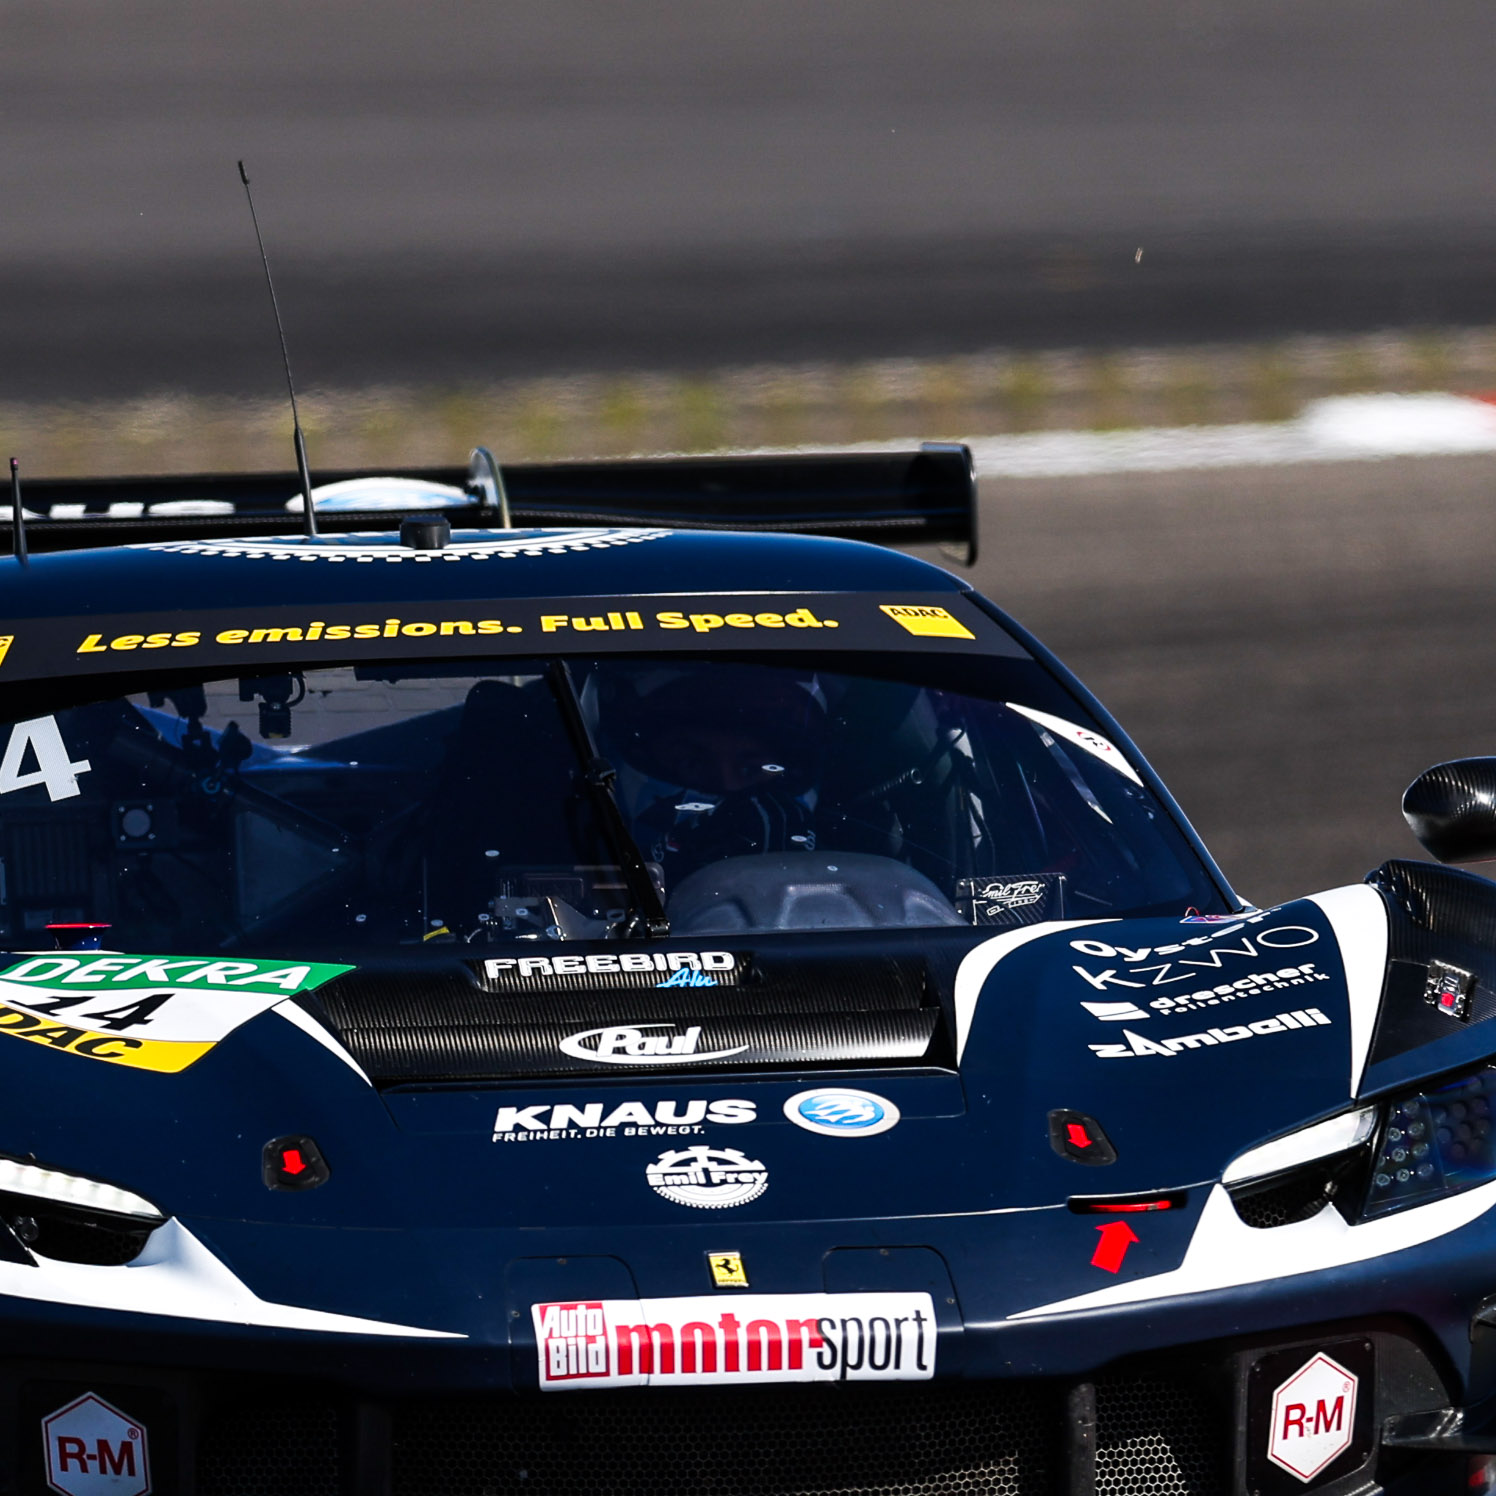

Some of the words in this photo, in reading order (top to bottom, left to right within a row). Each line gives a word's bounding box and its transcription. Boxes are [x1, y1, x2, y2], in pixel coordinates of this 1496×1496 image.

[889, 606, 950, 620] ADAC
[76, 631, 201, 653] Less
[216, 618, 523, 645] emissions.
[540, 611, 645, 632] Full
[655, 608, 840, 634] Speed.
[484, 951, 736, 979] FREEBIRD
[655, 967, 718, 988] Alu
[1149, 963, 1316, 1010] drescher
[8, 993, 176, 1032] 14
[595, 1025, 701, 1058] Paul
[494, 1098, 758, 1132] KNAUS
[491, 1128, 582, 1142] FREIHEIT.
[585, 1127, 617, 1138] DIE
[623, 1125, 706, 1137] BEWEGT.
[647, 1170, 706, 1187] Emil
[708, 1170, 769, 1187] Frey
[542, 1304, 604, 1339] Auto
[548, 1335, 607, 1376] Bild
[1282, 1395, 1345, 1441] R-M
[57, 1435, 136, 1478] R-M
